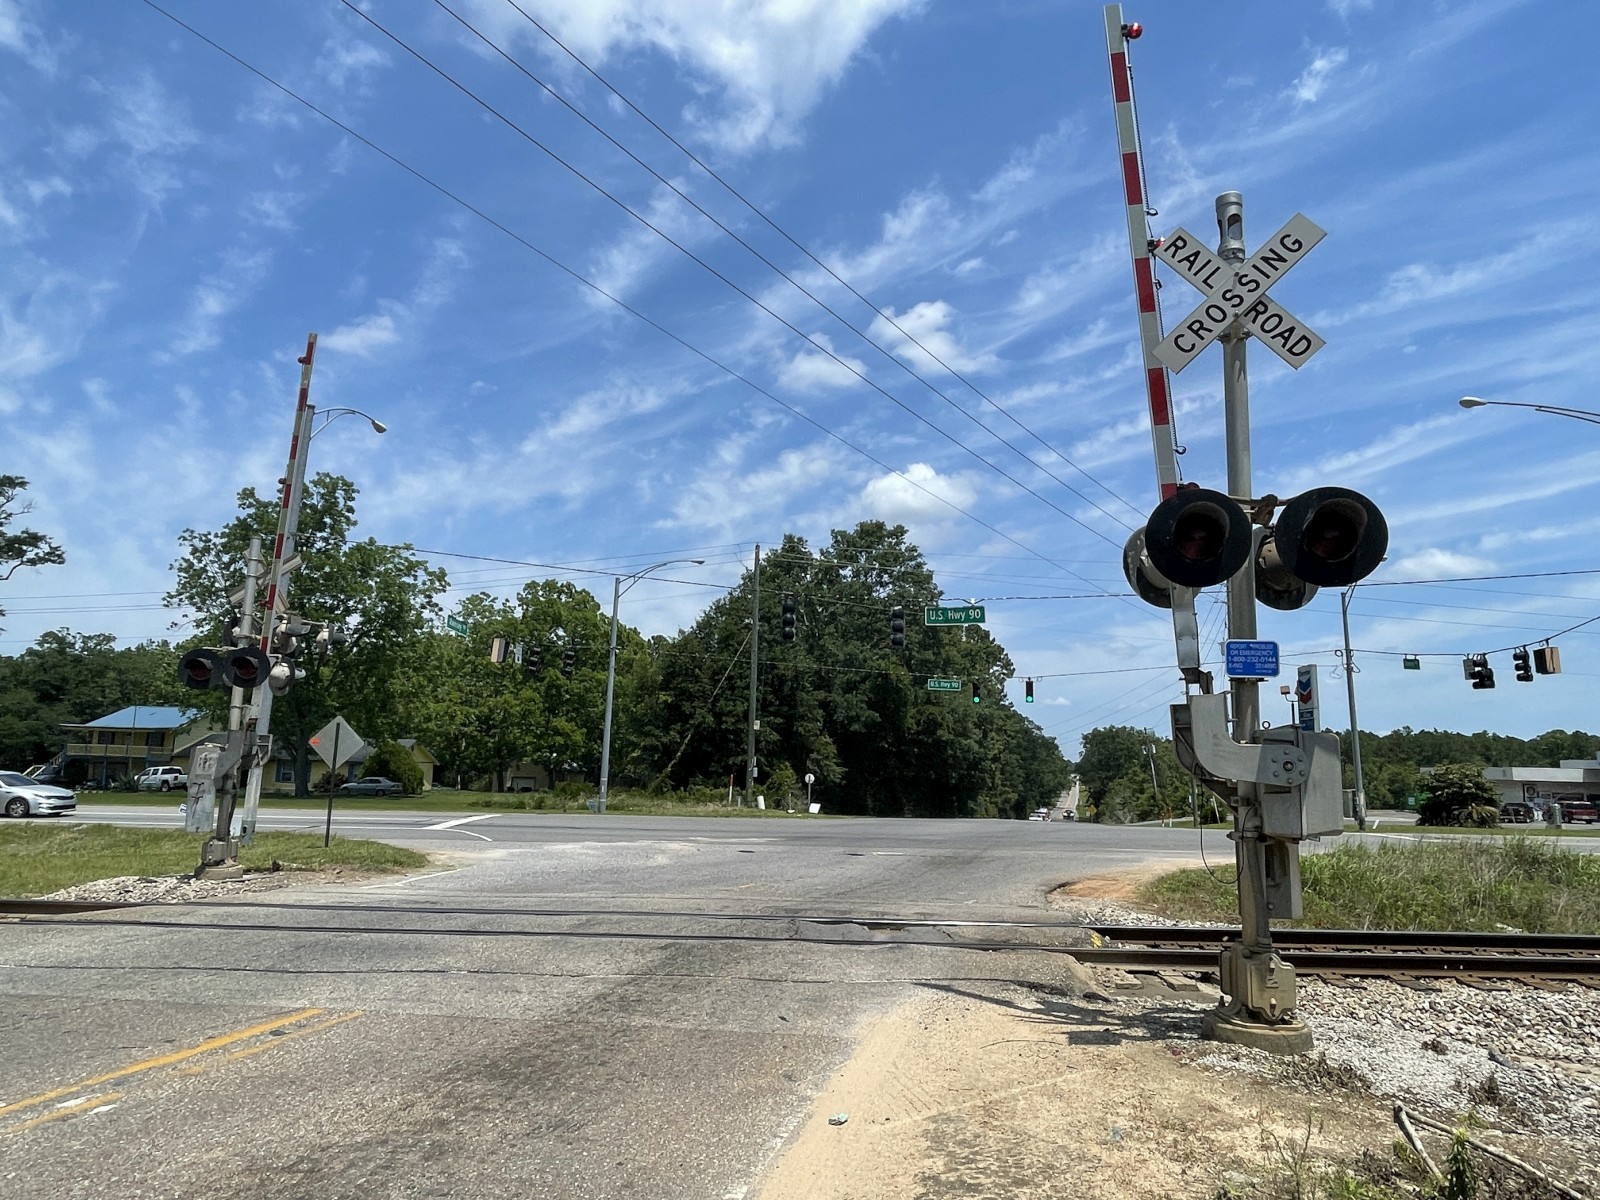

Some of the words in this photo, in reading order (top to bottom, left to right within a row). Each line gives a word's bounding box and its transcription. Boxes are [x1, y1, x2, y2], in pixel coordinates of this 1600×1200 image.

[1163, 235, 1221, 290] RAIL
[1243, 299, 1312, 357] ROAD
[1173, 233, 1303, 353] CROSSING
[930, 610, 945, 620] U.S.
[948, 610, 965, 621] Hwy
[969, 609, 981, 619] 90
